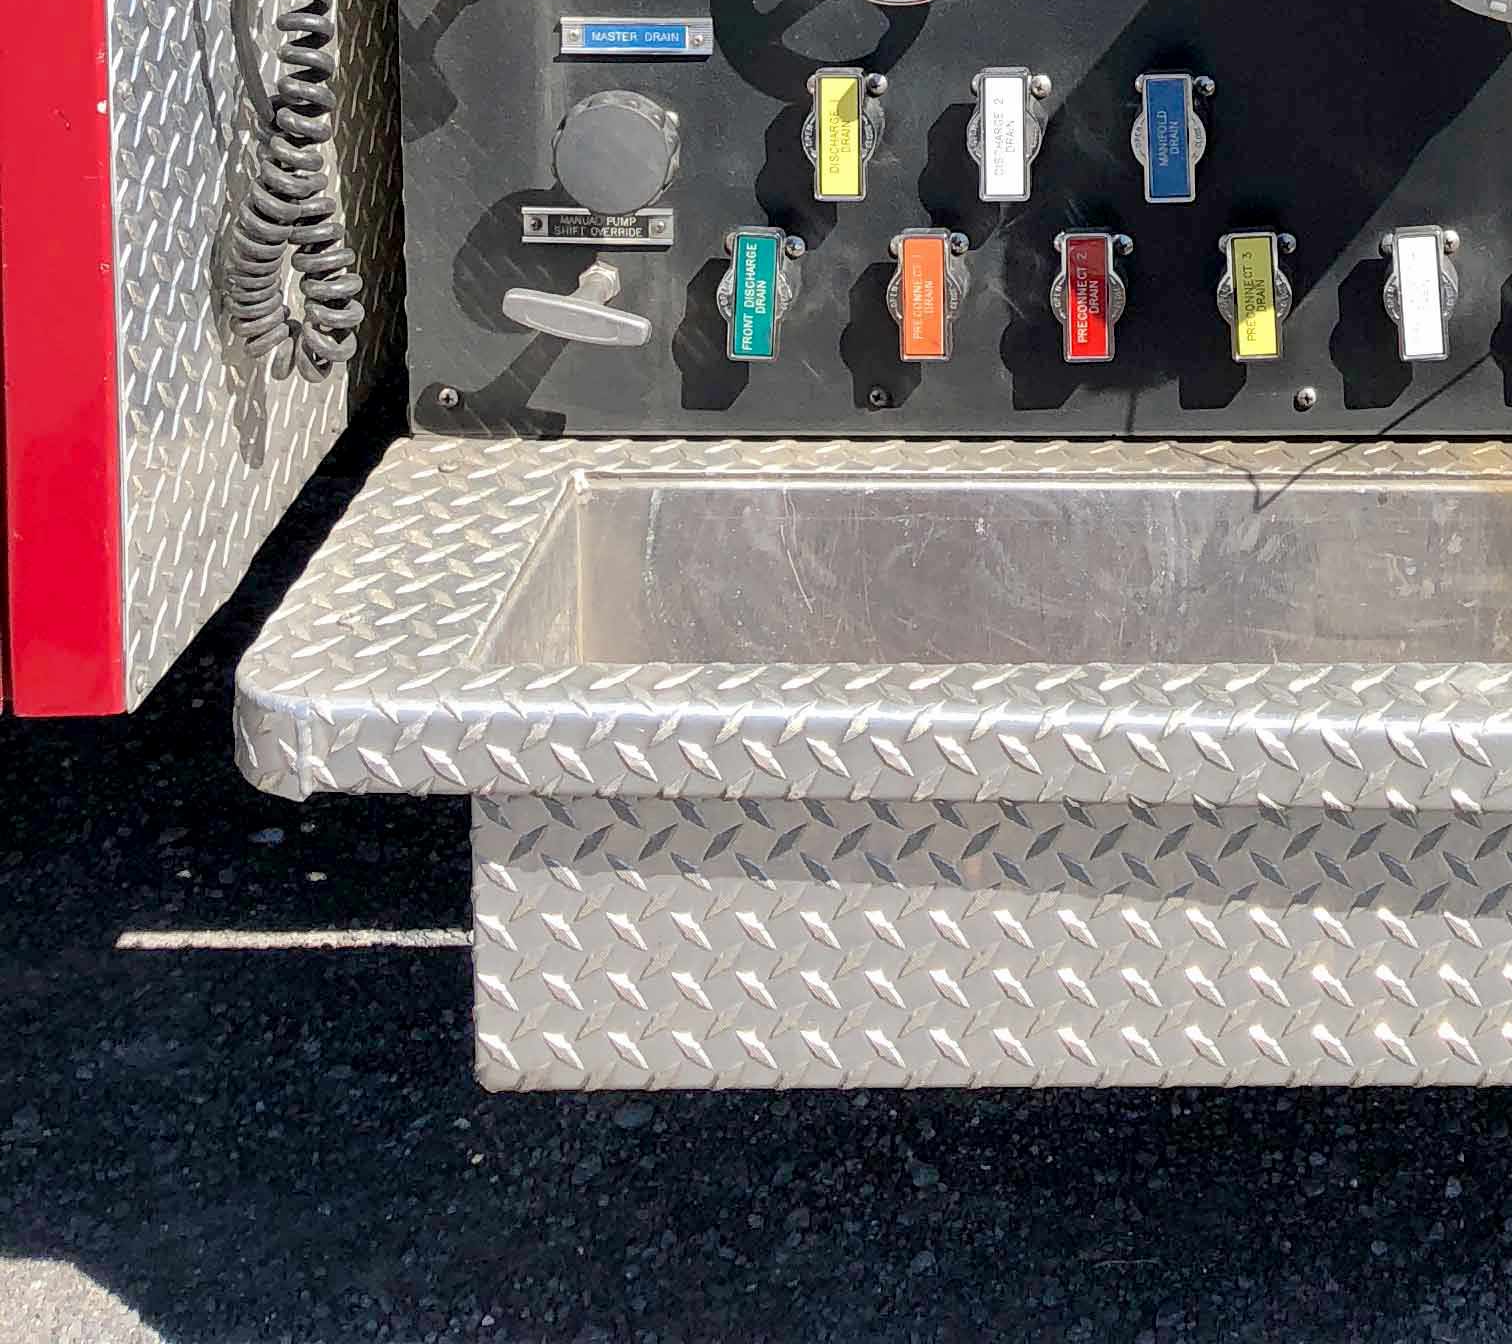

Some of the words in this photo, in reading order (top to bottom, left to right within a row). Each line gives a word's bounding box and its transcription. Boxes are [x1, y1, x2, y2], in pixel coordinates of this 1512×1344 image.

[592, 30, 638, 42] MASTER
[644, 32, 680, 42] DRAIN
[829, 114, 841, 175] DISCHARGE
[840, 121, 851, 154] DRAIN
[1158, 110, 1169, 168] MANIFOLD
[1169, 119, 1179, 156] DRAIN
[554, 226, 586, 236] SHIFT
[590, 226, 644, 238] OVERRIDE
[606, 216, 637, 227] PUMP
[1076, 251, 1088, 260] 2
[746, 242, 758, 306] DISCHARGE
[756, 280, 766, 315] DRAIN
[912, 264, 923, 340] PRECONNECT
[1076, 263, 1088, 344] PRECONNECT
[1090, 279, 1100, 315] DRAIN
[1246, 264, 1258, 342] PRECONNECT
[1256, 278, 1266, 314] DRAIN
[742, 312, 752, 351] FRONT
